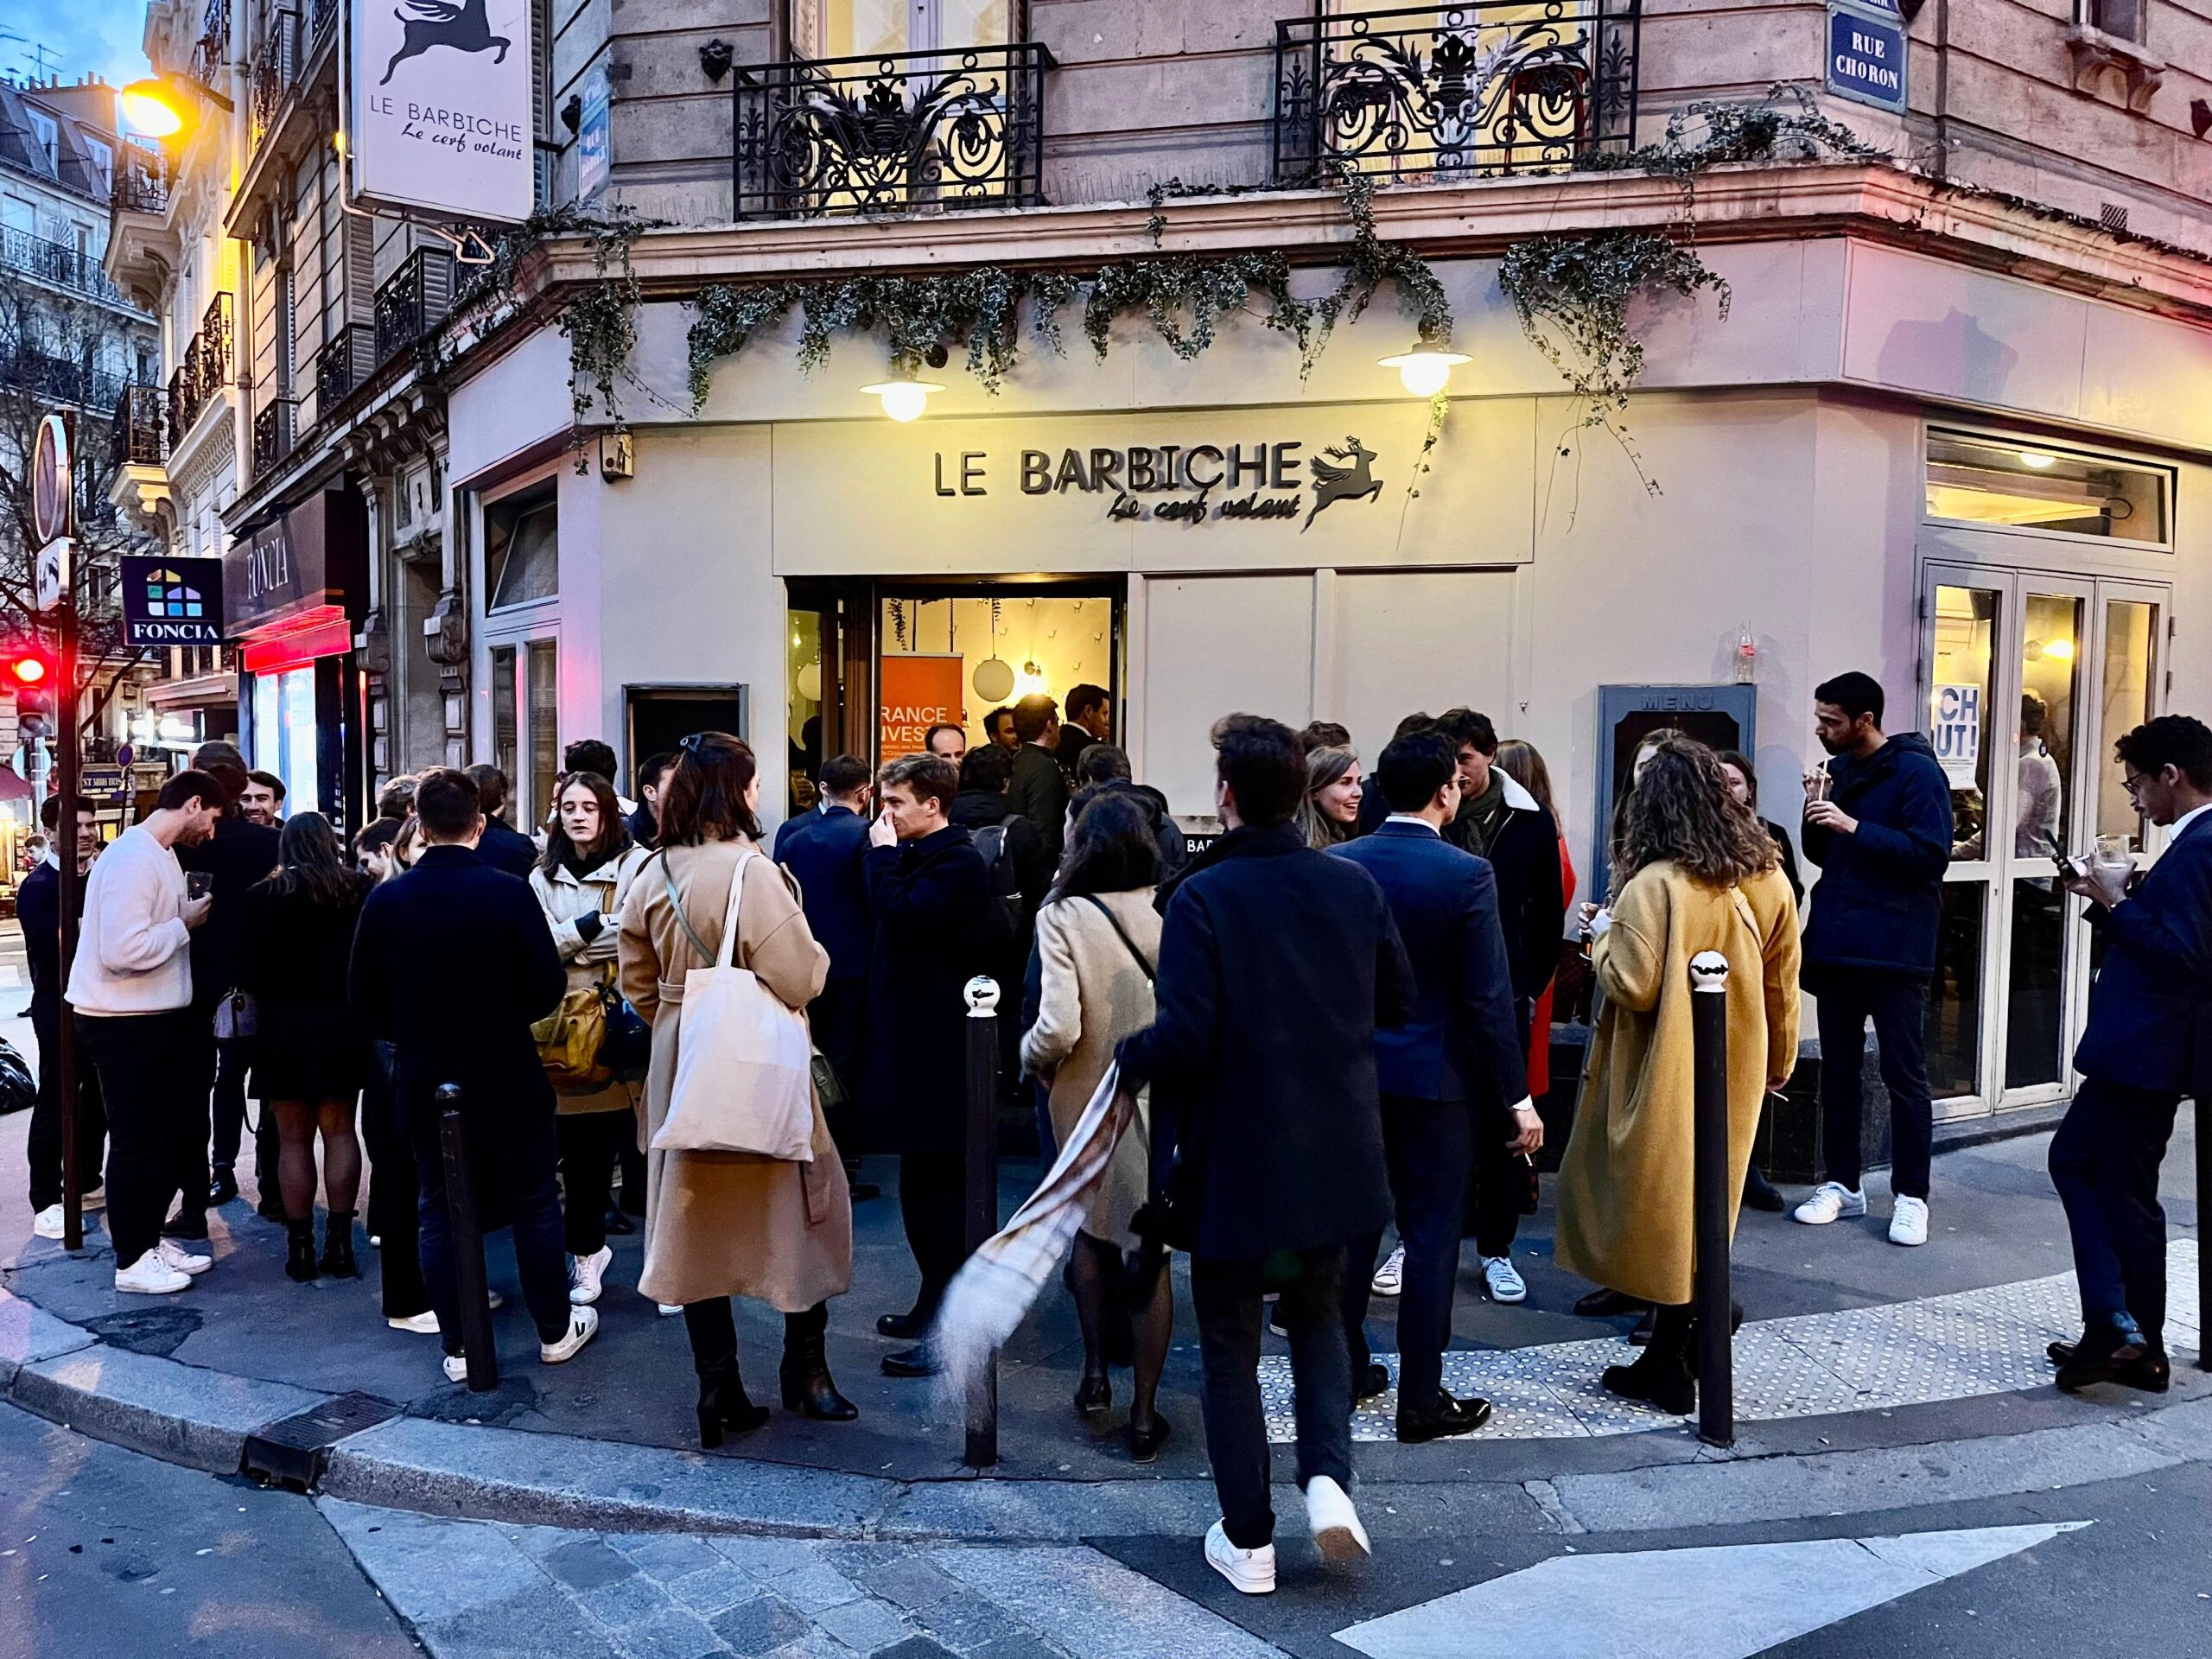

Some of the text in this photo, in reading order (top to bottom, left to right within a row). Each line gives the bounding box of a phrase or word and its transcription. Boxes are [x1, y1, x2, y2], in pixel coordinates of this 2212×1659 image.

[1852, 31, 1885, 58] RUE
[1836, 54, 1898, 90] CHORON
[370, 94, 522, 143] LE BARBICHE
[401, 122, 522, 161] Le cerf volant
[934, 442, 1303, 496] LE BARBICHE
[1107, 488, 1301, 524] Le cerf volant
[246, 535, 289, 600] FONCIA
[133, 623, 219, 639] FONCIA
[1641, 693, 1714, 711] MENU
[1939, 687, 1979, 721] CH
[880, 725, 929, 742] VES
[1936, 724, 1977, 757] UT!
